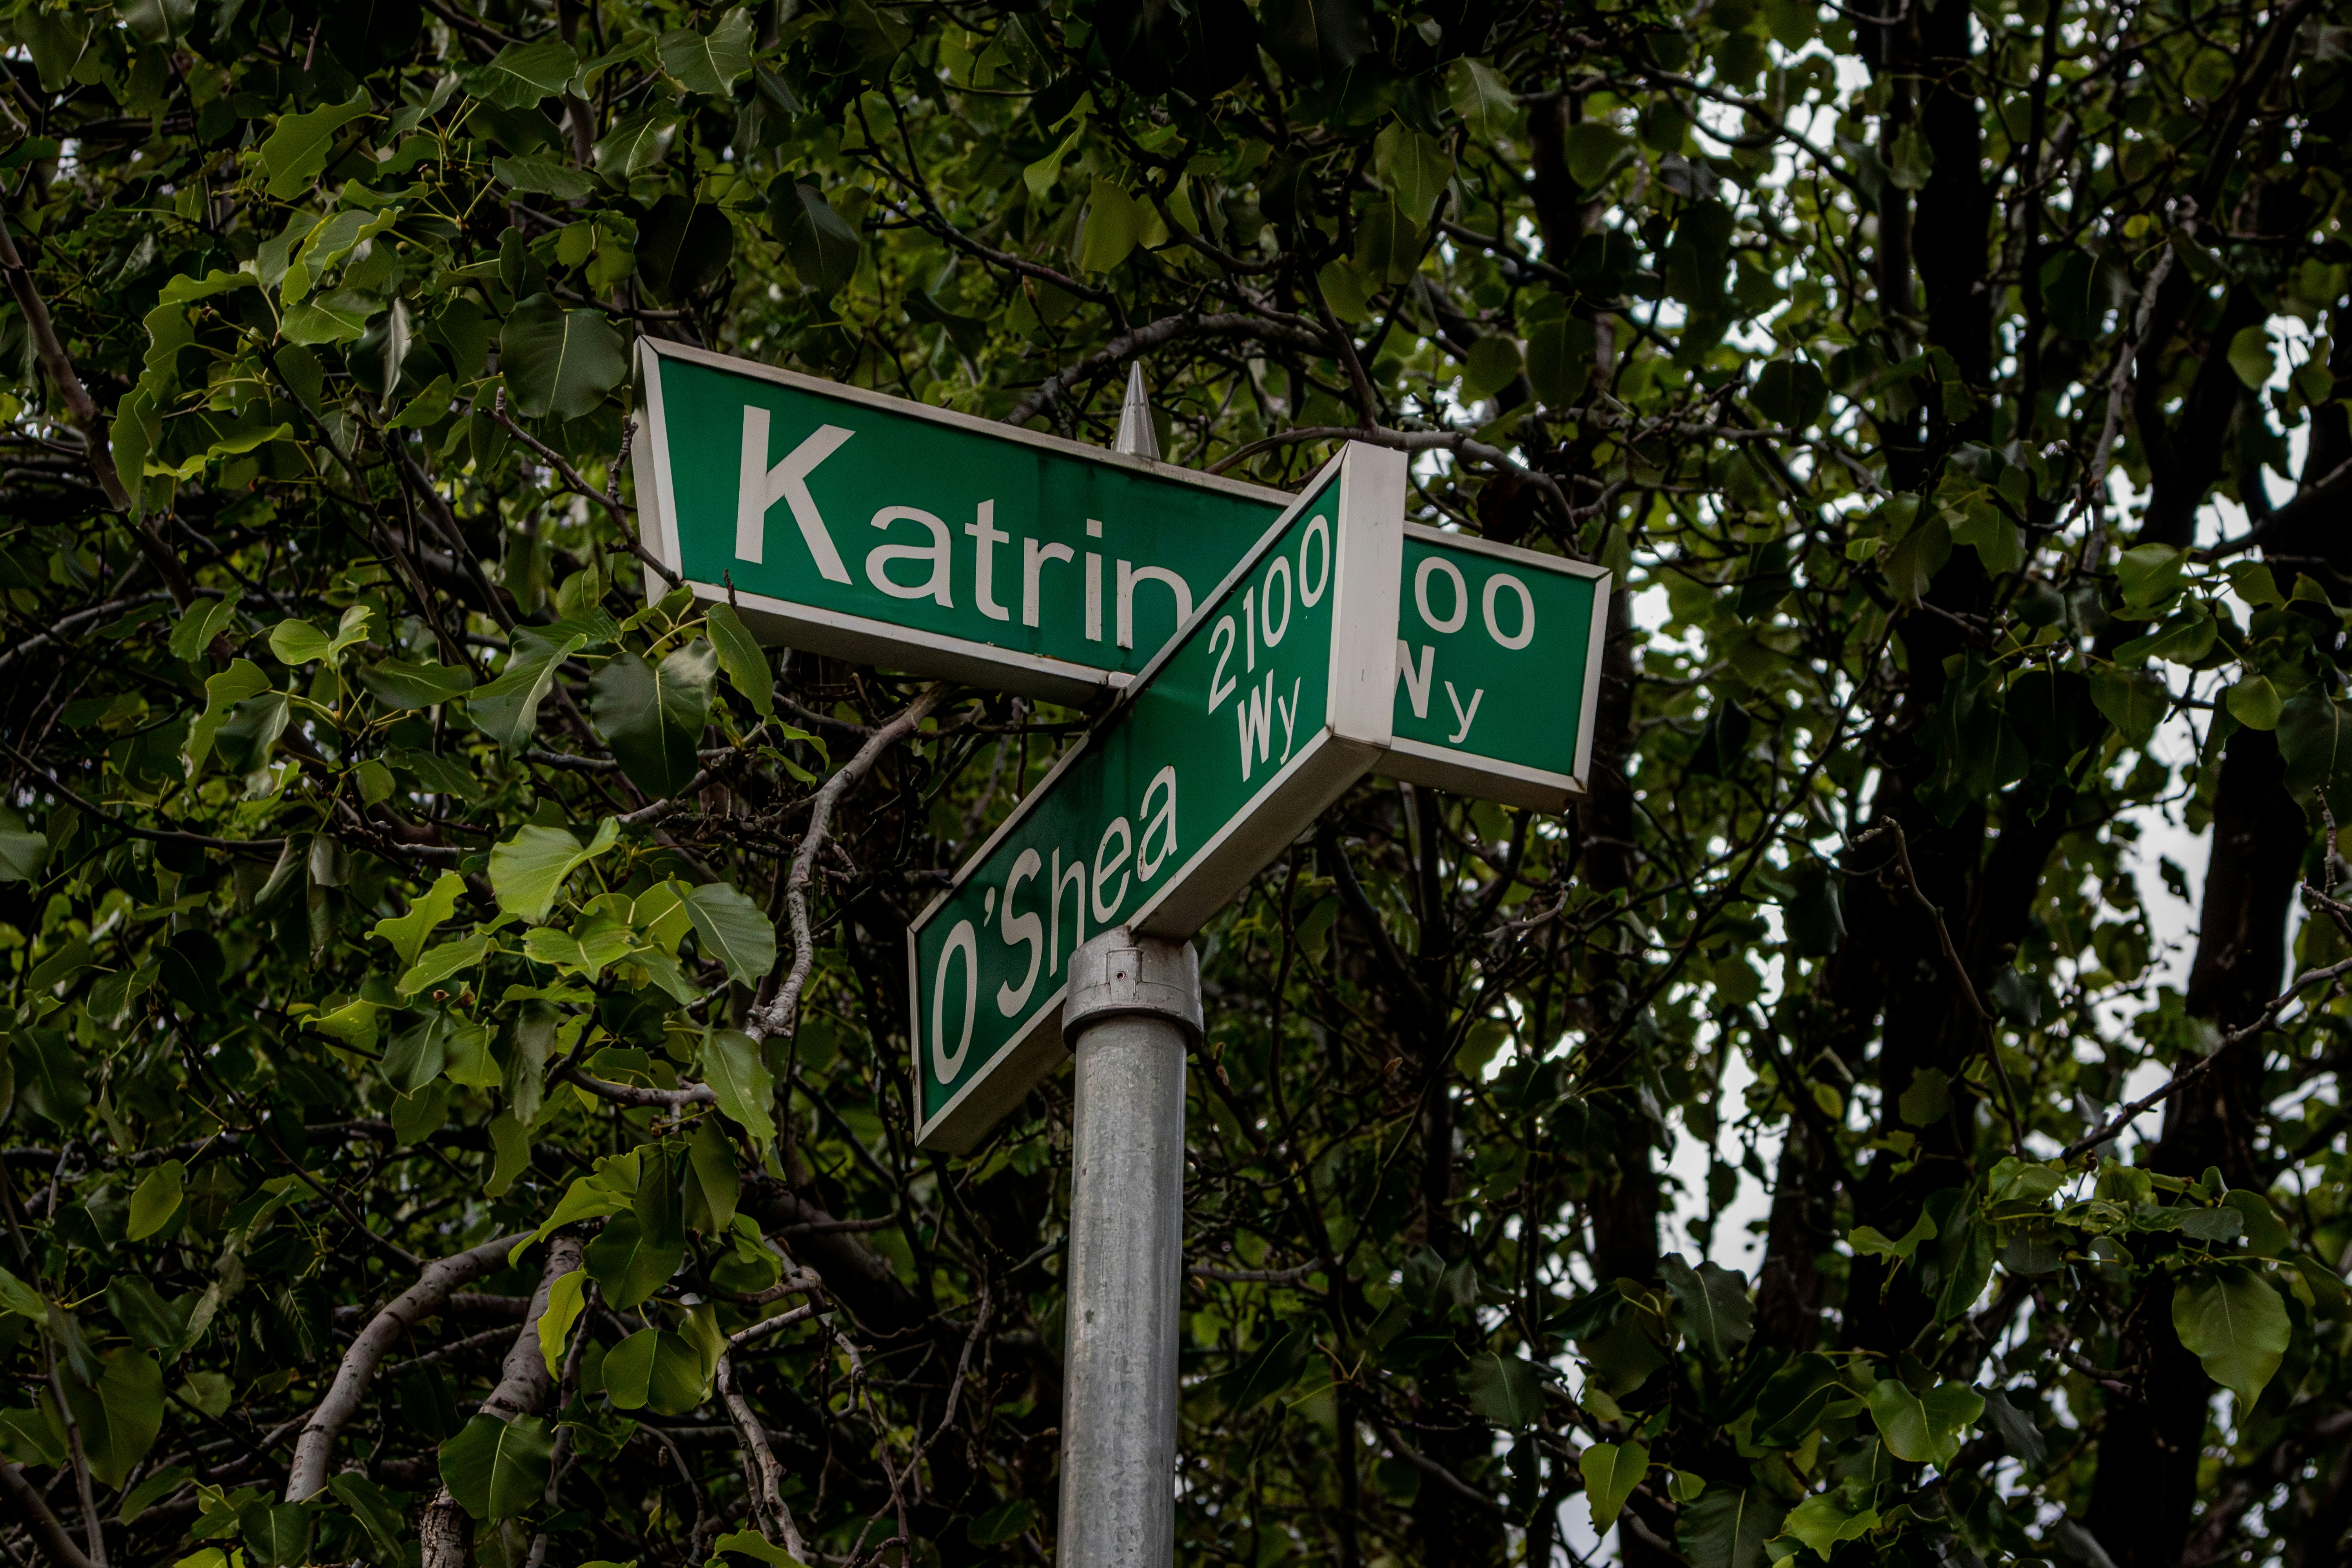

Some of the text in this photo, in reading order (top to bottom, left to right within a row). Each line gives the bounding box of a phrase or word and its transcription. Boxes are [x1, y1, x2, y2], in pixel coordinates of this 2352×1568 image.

[1208, 514, 1330, 715] 2100
[1237, 668, 1301, 783] Wy
[932, 765, 1178, 1085] O'Shea
